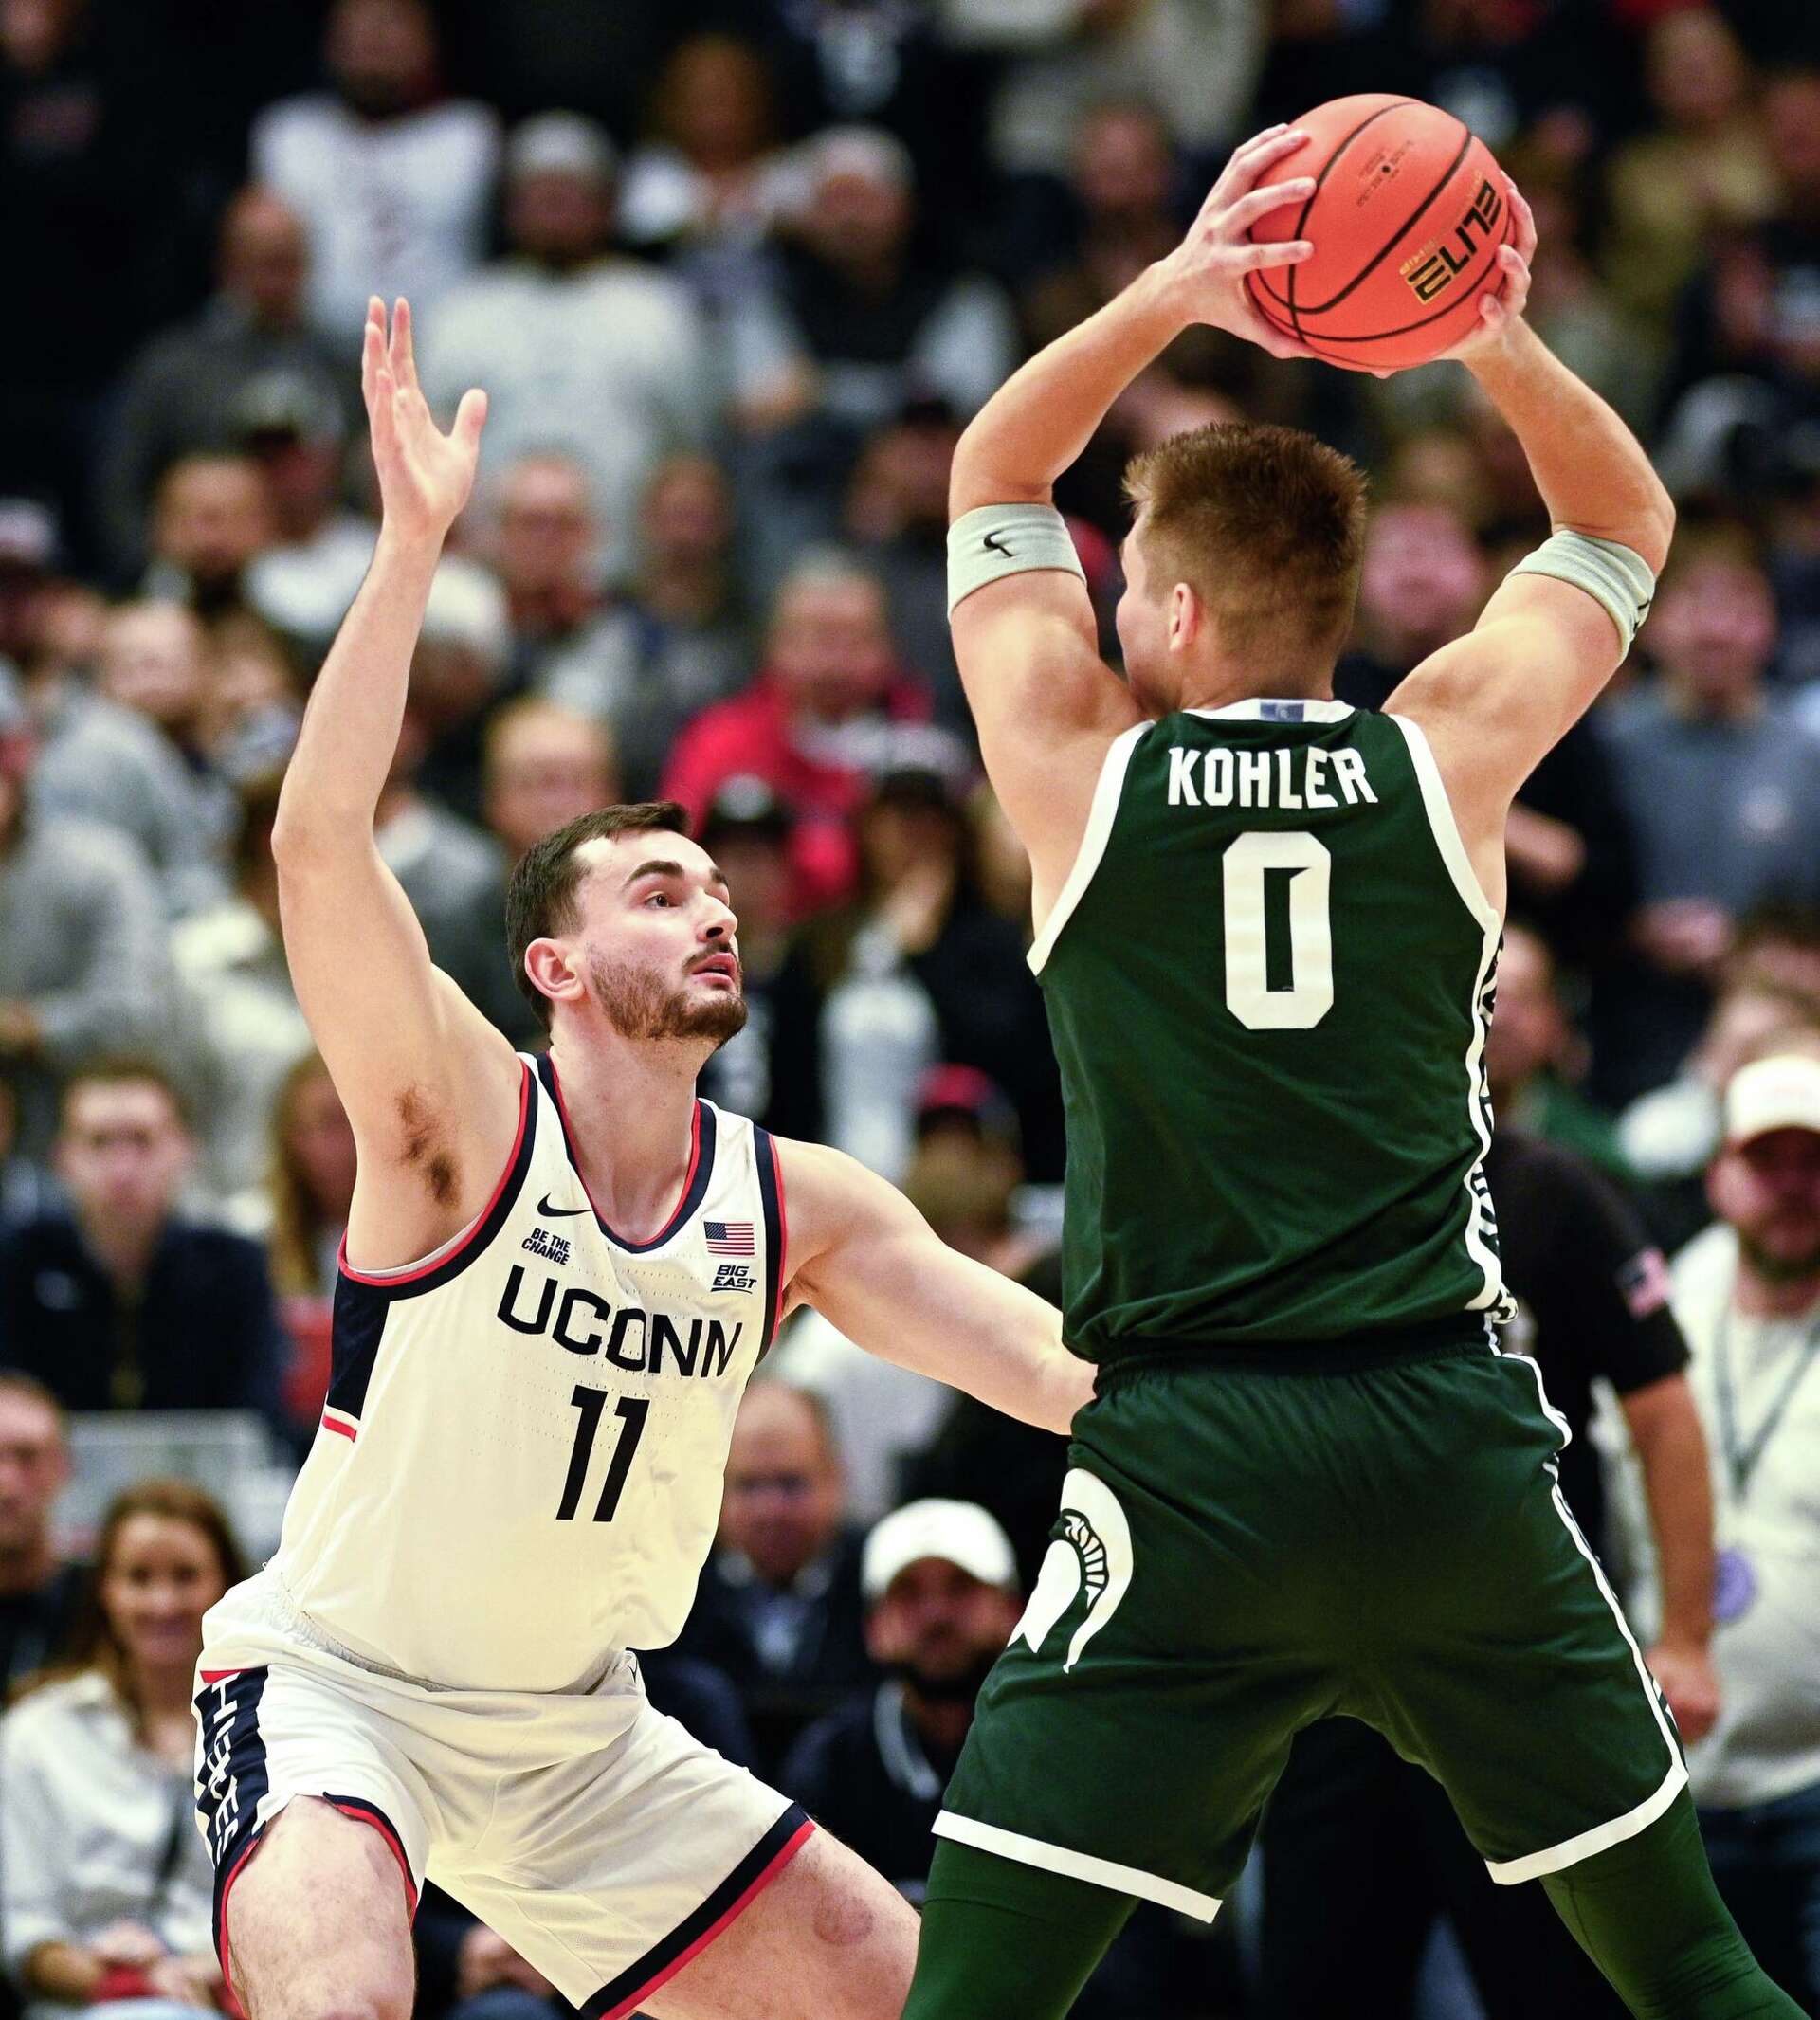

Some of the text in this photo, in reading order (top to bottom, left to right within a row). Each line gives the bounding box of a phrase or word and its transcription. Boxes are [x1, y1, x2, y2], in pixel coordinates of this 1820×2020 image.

[1406, 179, 1502, 303] ELITE
[1167, 745, 1379, 810] KOHLER
[1222, 830, 1335, 1030] 0
[521, 1237, 571, 1266] CHANGE
[531, 1227, 572, 1253] BE THE
[716, 1265, 750, 1277] BIG
[712, 1276, 757, 1289] EAST
[496, 1264, 743, 1378] UCONN
[555, 1384, 650, 1523] 11
